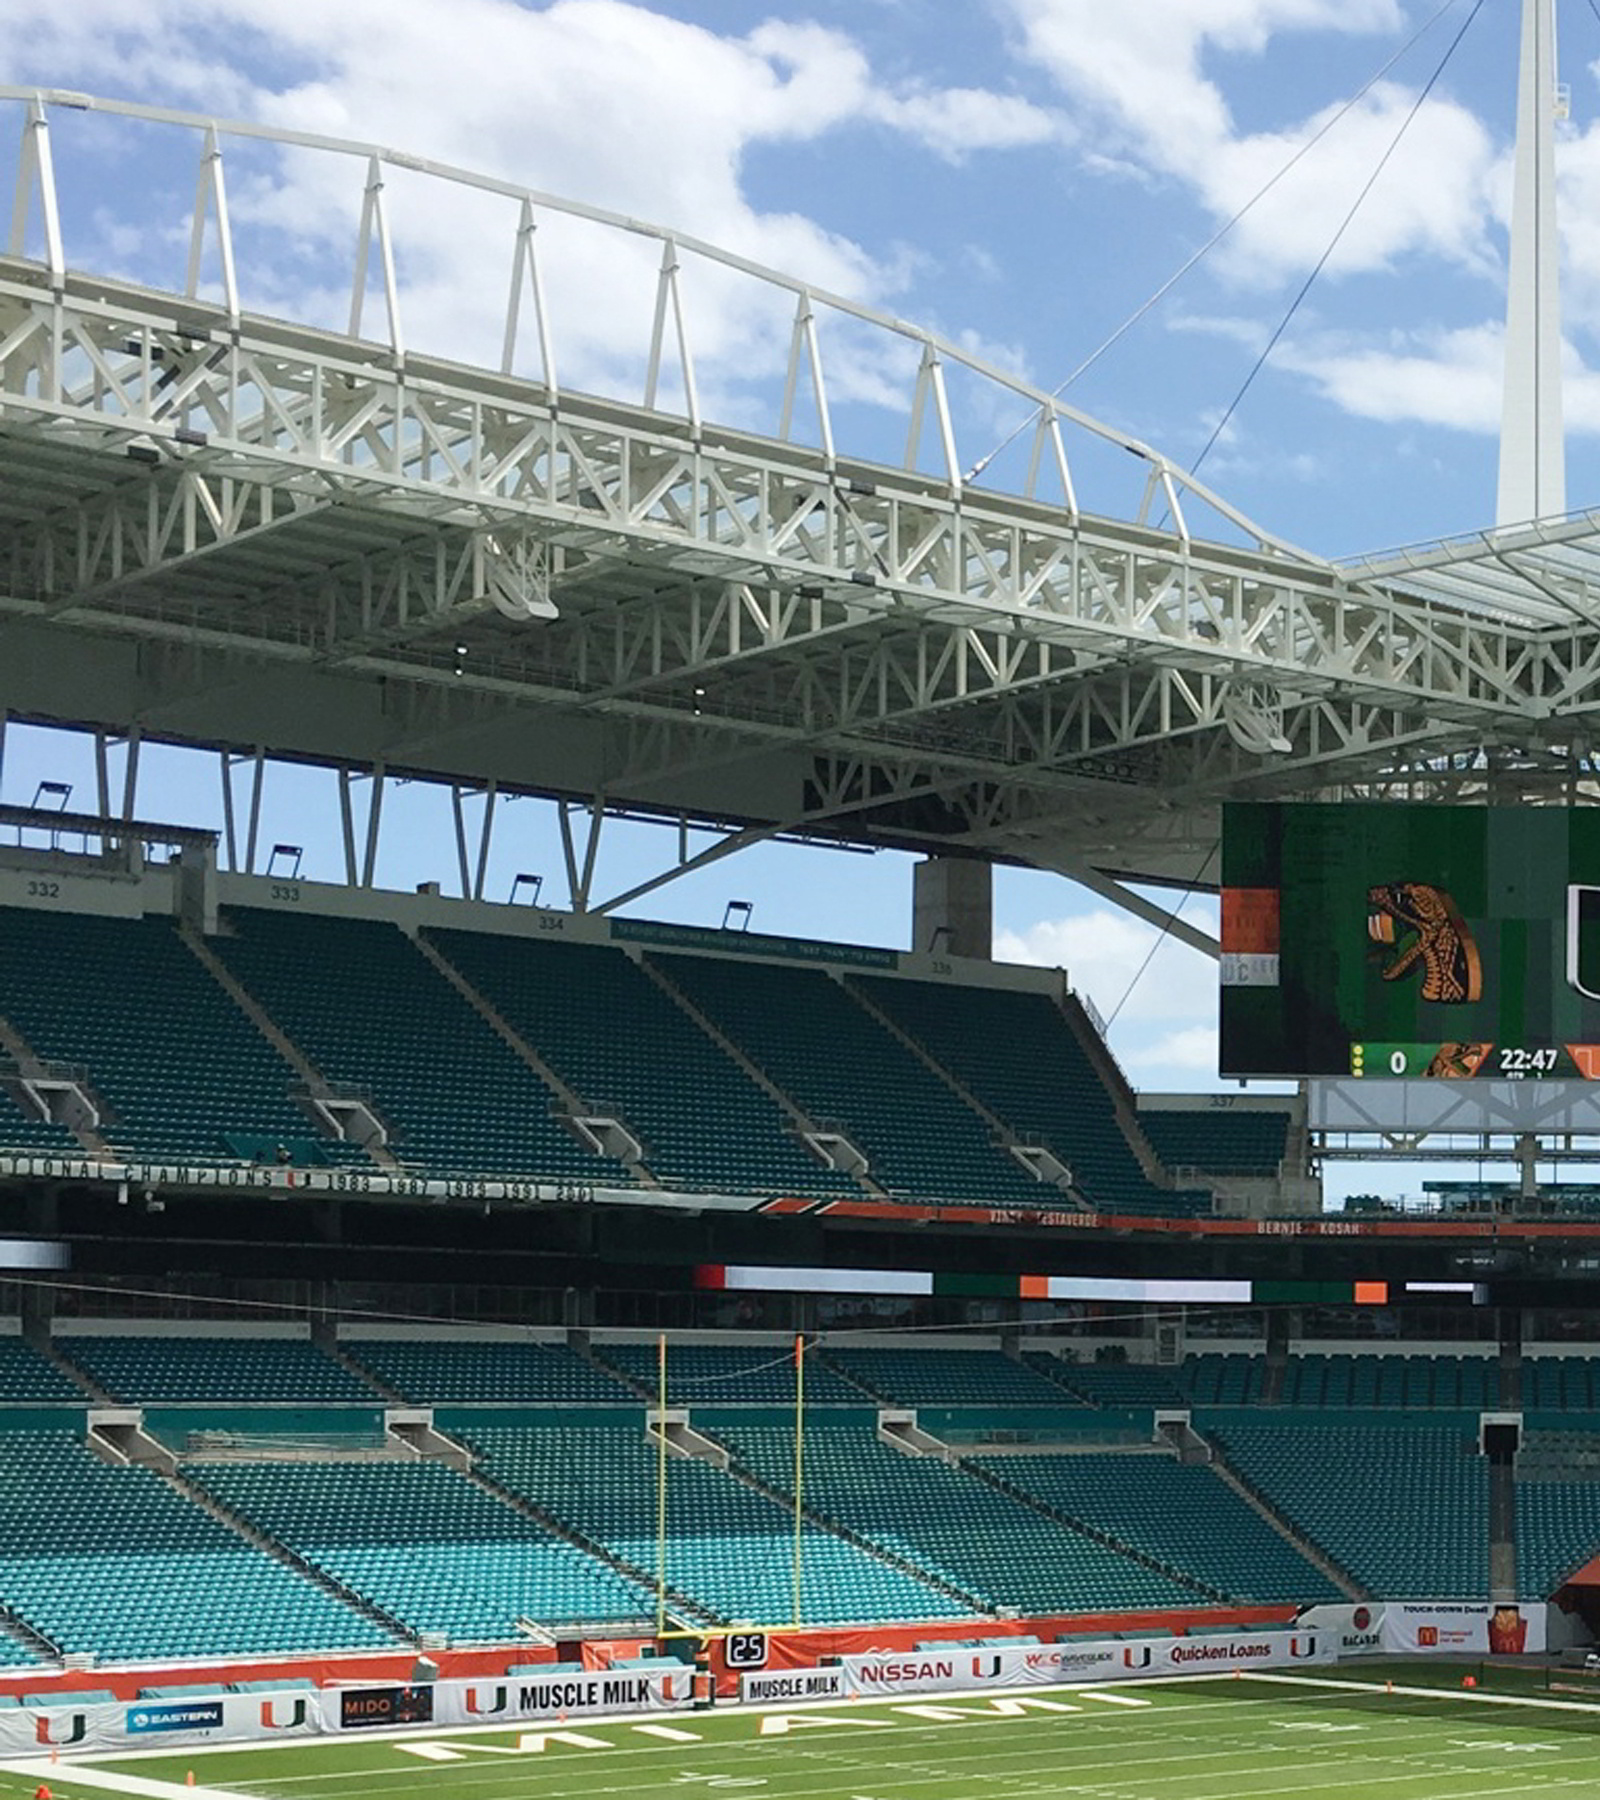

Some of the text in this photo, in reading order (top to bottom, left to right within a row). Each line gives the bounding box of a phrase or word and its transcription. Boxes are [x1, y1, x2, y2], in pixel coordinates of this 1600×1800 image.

[28, 881, 60, 899] 332
[271, 885, 300, 902] 333
[539, 916, 564, 930] 334
[1390, 1050, 1407, 1075] 0
[1500, 1048, 1558, 1071] 22:47
[1257, 1222, 1303, 1235] BERNIE
[733, 1635, 762, 1662] 25
[1123, 1646, 1151, 1669] U
[1170, 1642, 1272, 1664] Quicken Loans
[1289, 1636, 1317, 1660] U
[860, 1661, 953, 1683] NISSAN
[972, 1655, 1001, 1678] U
[519, 1677, 651, 1712] MUSCLE MILK
[750, 1676, 840, 1699] MUSCLE MILK
[344, 1698, 392, 1716] MIDO
[466, 1686, 508, 1714] U
[150, 1709, 220, 1726] EASTERN
[261, 1699, 307, 1728] U
[36, 1714, 87, 1745] U
[393, 1692, 1152, 1761] MIAMI
